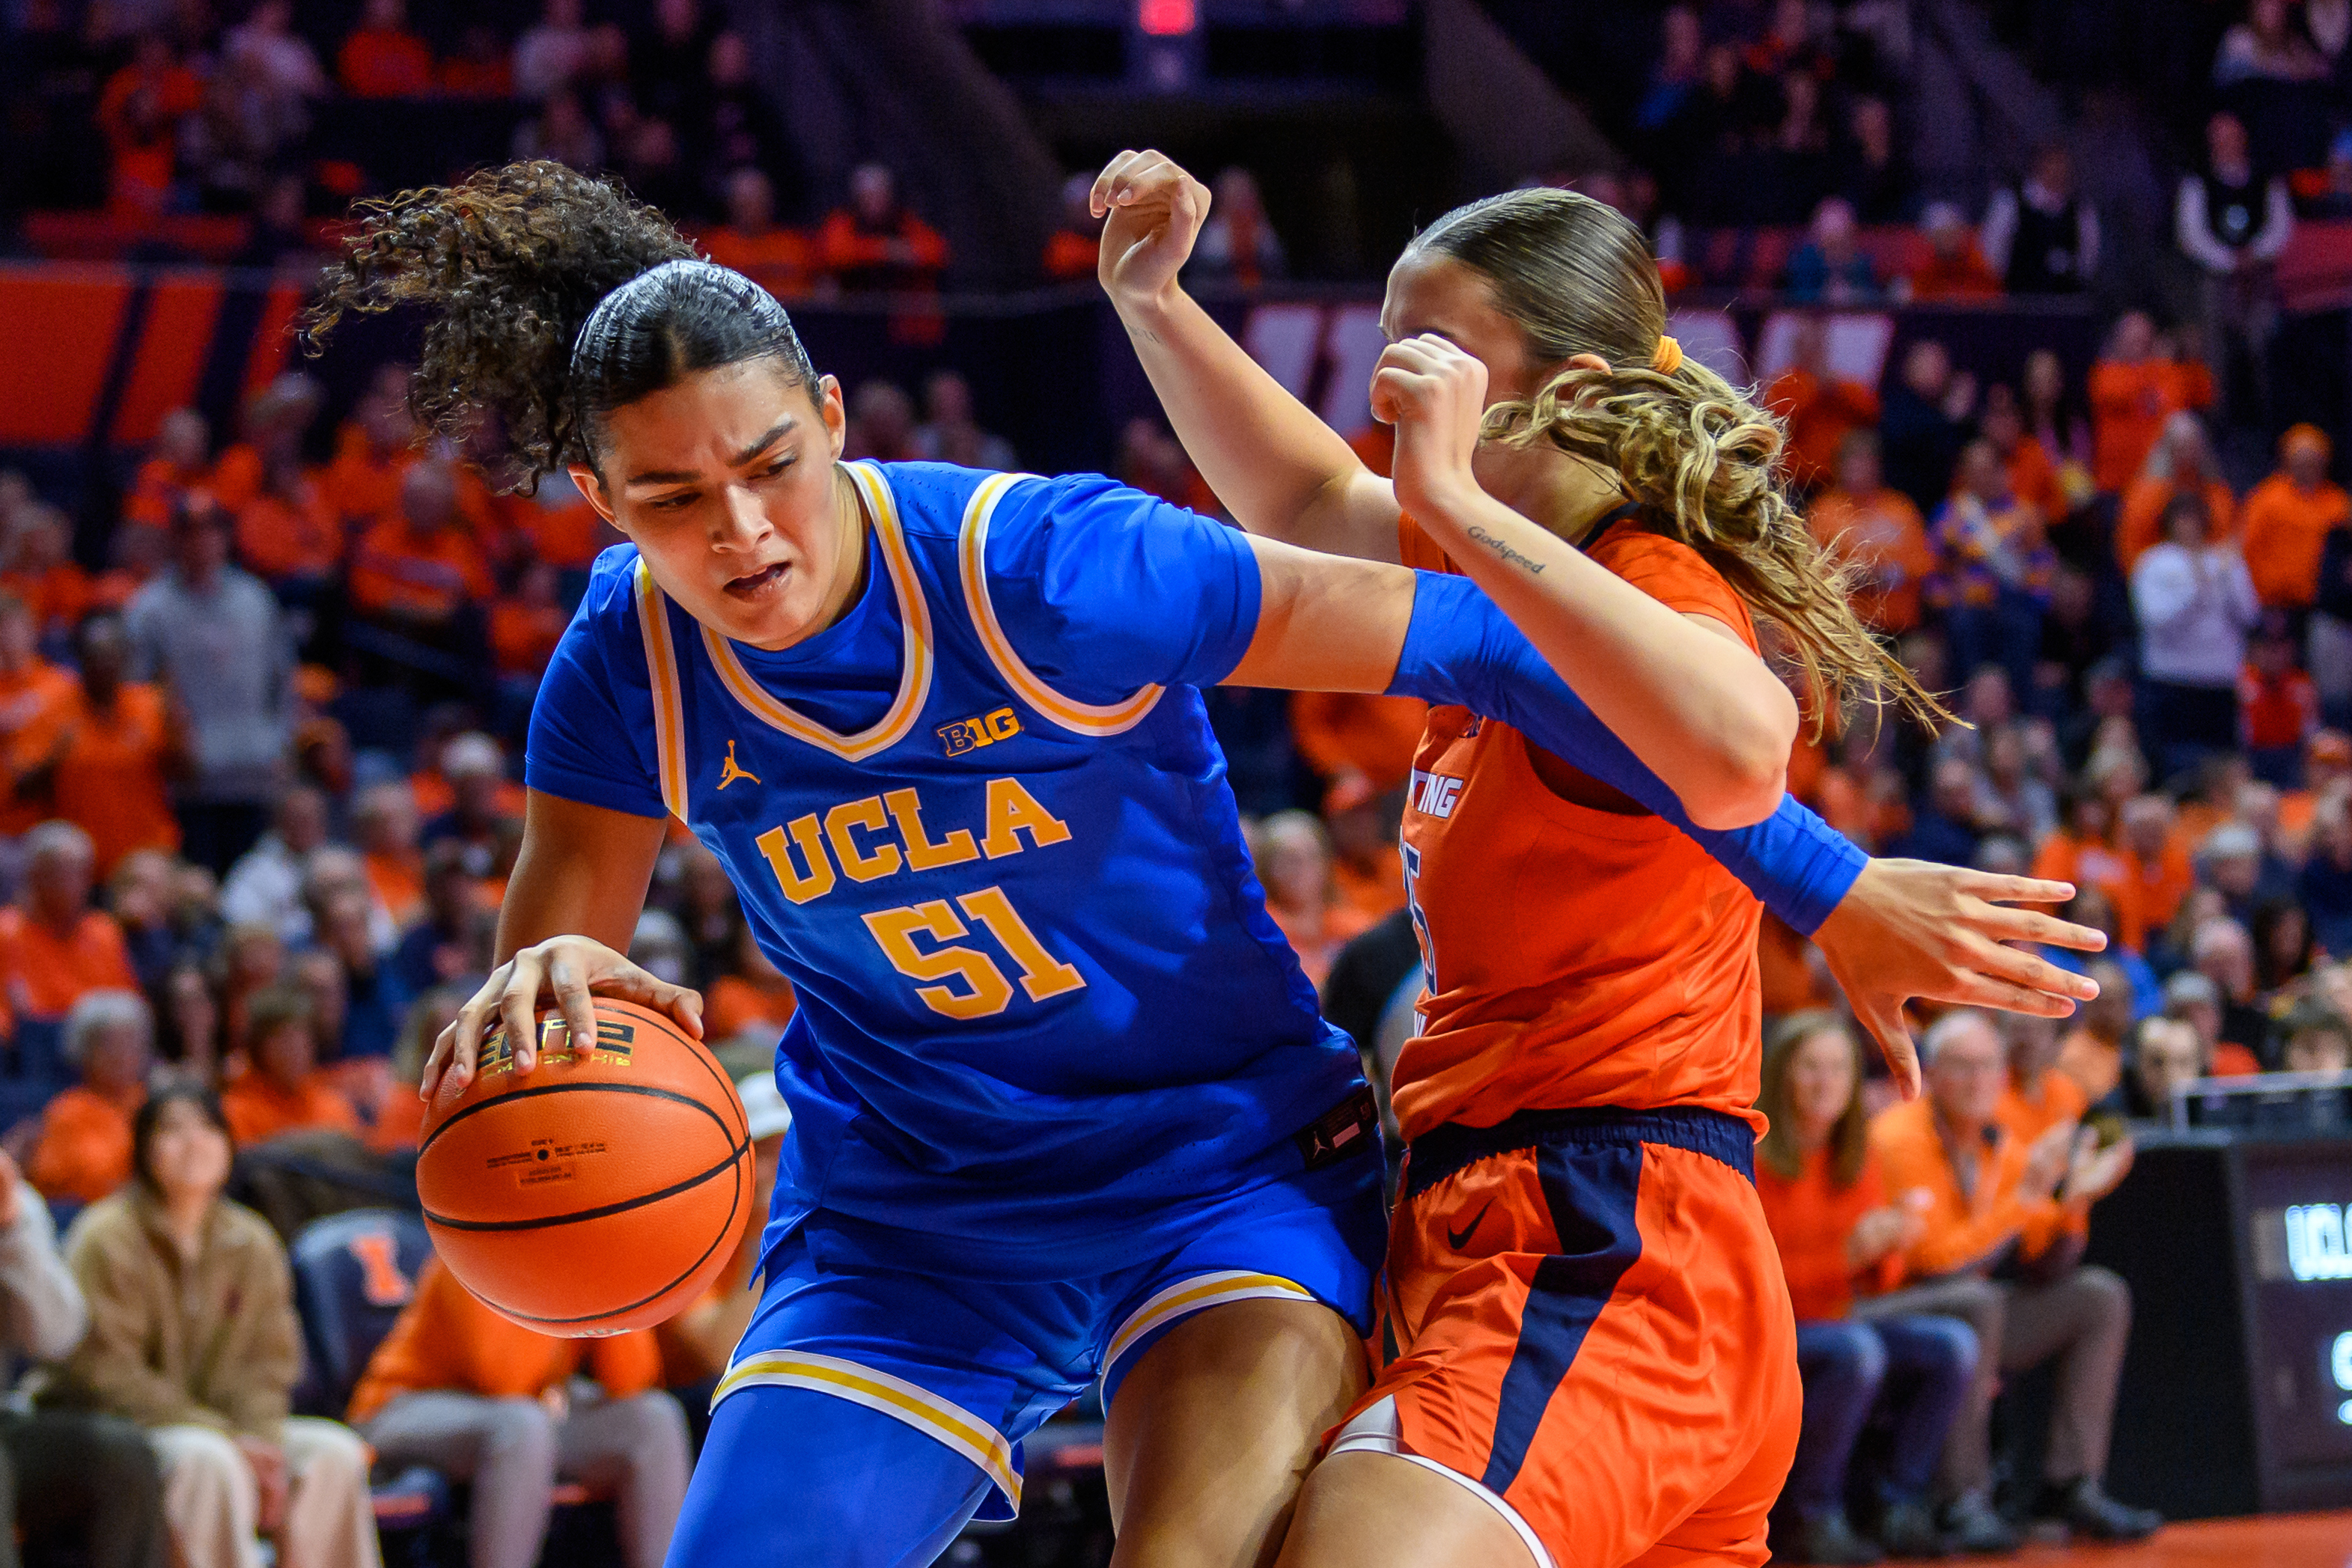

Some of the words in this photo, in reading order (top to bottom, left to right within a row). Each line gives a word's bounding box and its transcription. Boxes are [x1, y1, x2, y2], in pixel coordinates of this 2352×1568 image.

[1467, 526, 1546, 574] Godspeed
[755, 777, 1073, 905] UCLA
[860, 885, 1088, 1021] 51
